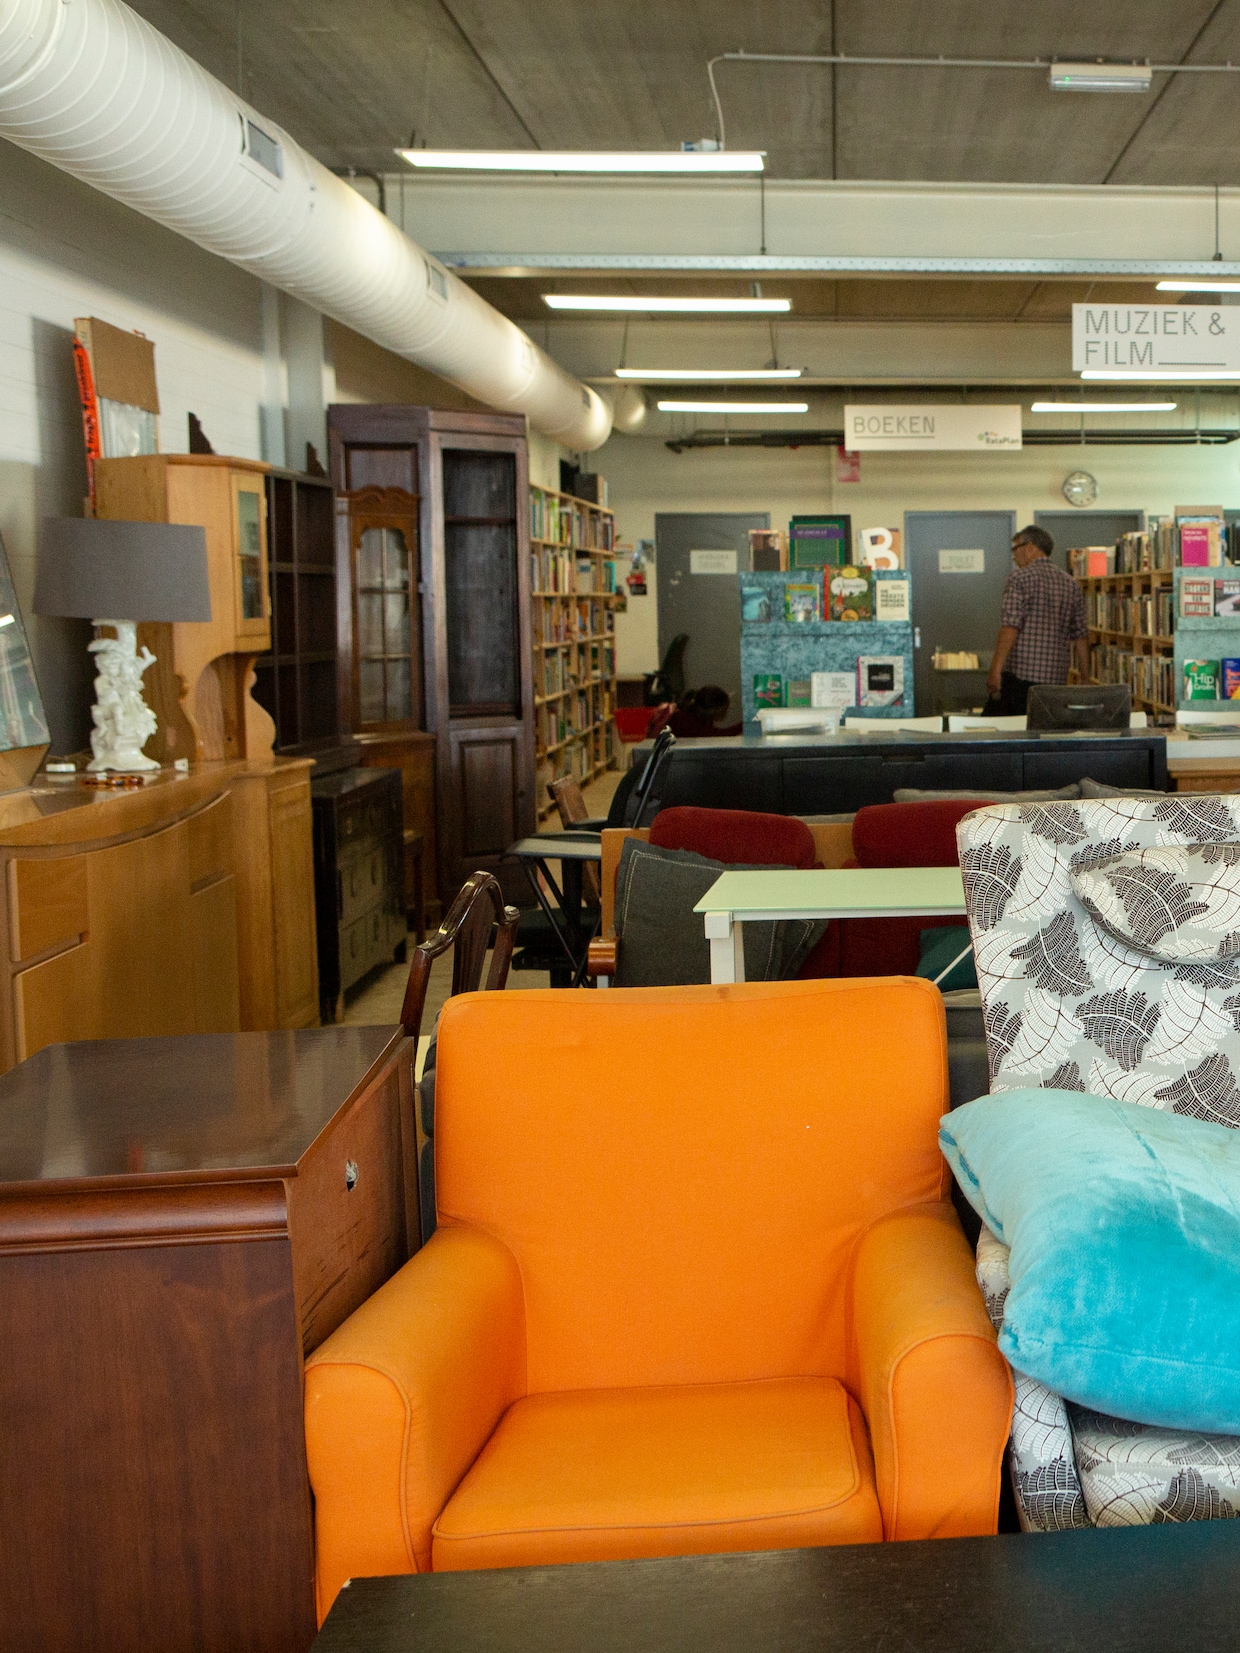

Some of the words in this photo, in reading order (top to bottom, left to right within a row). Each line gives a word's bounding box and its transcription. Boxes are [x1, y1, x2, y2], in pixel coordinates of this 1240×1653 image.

[1085, 310, 1198, 335] MUZIEK
[1208, 312, 1226, 335] &
[853, 416, 935, 433] BOEKEN
[861, 527, 899, 570] B
